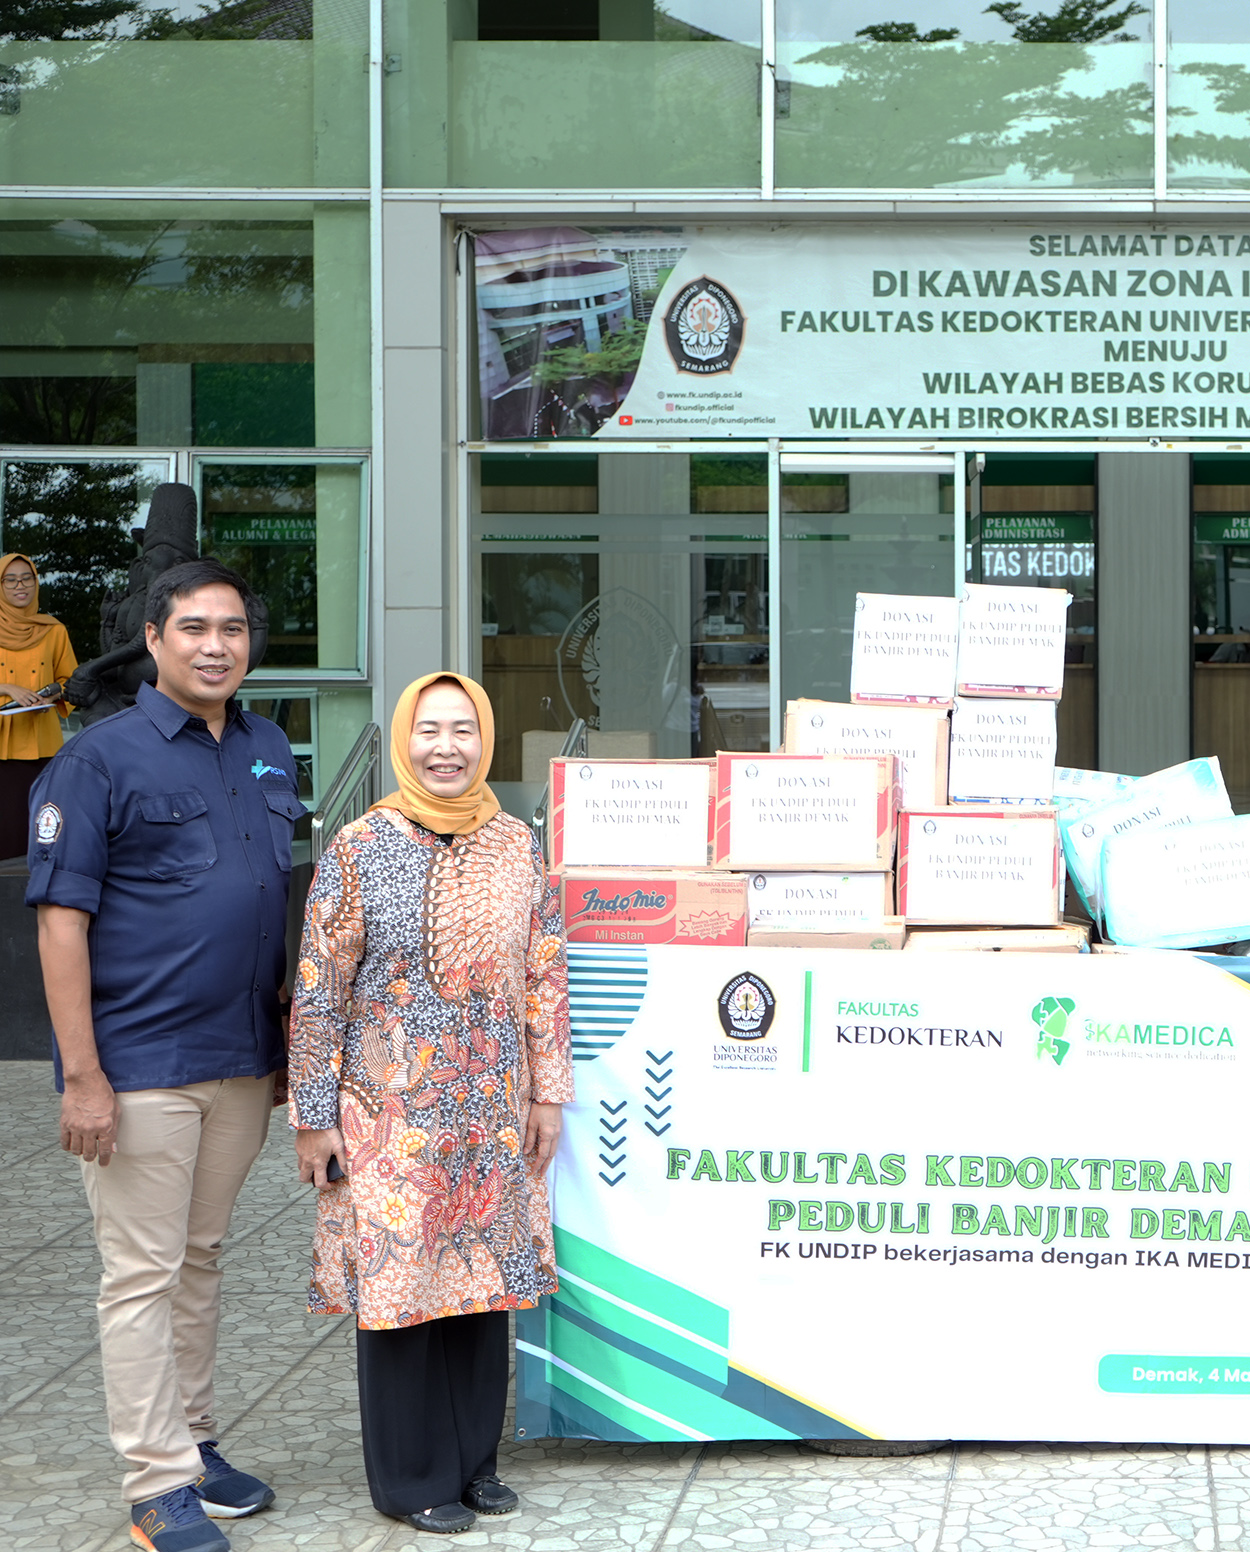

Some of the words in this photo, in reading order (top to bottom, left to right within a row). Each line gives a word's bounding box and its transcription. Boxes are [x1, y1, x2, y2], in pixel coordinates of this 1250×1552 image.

[1029, 234, 1167, 256] SELAMAT
[873, 270, 908, 297] DI
[919, 270, 1116, 297] KAWASAN
[1127, 270, 1233, 296] ZONA
[670, 284, 699, 323] UNIVERSITAS
[707, 284, 739, 324] DIPONEGORO
[781, 311, 933, 332] FAKULTAS
[942, 311, 1141, 332] KEDOKTERAN
[1104, 340, 1227, 361] MENUJU
[680, 360, 729, 373] SEMARANG
[923, 372, 1063, 393] WILAYAH
[1072, 372, 1165, 393] BEBAS
[667, 392, 743, 400] www.fk.undip.ac.id
[675, 404, 734, 412] fkundip.official
[635, 416, 776, 425] www.youtube.com/@fkundipofficial
[809, 408, 949, 428] WILAYAH
[958, 407, 1117, 428] BIROKRASI
[1127, 406, 1227, 428] BERSIH
[986, 517, 1056, 528] PELAYANAN
[221, 530, 268, 540] ALUMNI
[272, 530, 281, 540] &
[988, 603, 1037, 613] DONASI
[883, 612, 932, 623] DONASI
[876, 632, 911, 640] UNDIP
[969, 636, 1008, 645] BANJIR
[864, 646, 903, 655] BANJIR
[977, 715, 1026, 725] DONASI
[842, 728, 891, 738] DONASI
[958, 749, 997, 757] BANJIR
[612, 780, 662, 789] DONASI
[778, 777, 830, 787] DONASI
[604, 800, 641, 808] UNDIP
[645, 801, 687, 809] PEDULI
[771, 798, 808, 807] UNDIP
[813, 798, 855, 807] PEDULI
[593, 815, 633, 823] BANJIR
[759, 814, 800, 823] BANJIR
[1112, 806, 1163, 834] DONASI
[956, 835, 1006, 845] DONASI
[948, 855, 985, 864] UNDIP
[989, 856, 1031, 865] PEDULI
[936, 870, 977, 880] BANJIR
[786, 889, 837, 899] DONASI
[595, 930, 608, 940] Mi
[610, 930, 644, 940] Instan
[720, 975, 747, 1005] UNIVERSITAS
[748, 975, 774, 1006] DIPONEGORO
[838, 1001, 918, 1017] FAKULTAS
[837, 1026, 1002, 1047] KEDOKTERAN
[713, 1045, 777, 1054] UNIVERSITAS
[713, 1053, 778, 1062] DIPONEGORO
[666, 1148, 906, 1186] FAKULTAS
[925, 1155, 1232, 1193] KEDOKTERAN
[768, 1199, 930, 1234] PEDULI
[955, 1203, 1110, 1242] BANJIR
[761, 1242, 790, 1258] FK
[799, 1243, 877, 1259] UNDIP
[885, 1244, 1033, 1265] bekerjasama
[1041, 1247, 1127, 1269] dengan
[1135, 1250, 1179, 1267] IKA
[1132, 1366, 1202, 1387] Demak,
[1207, 1367, 1219, 1382] 4
